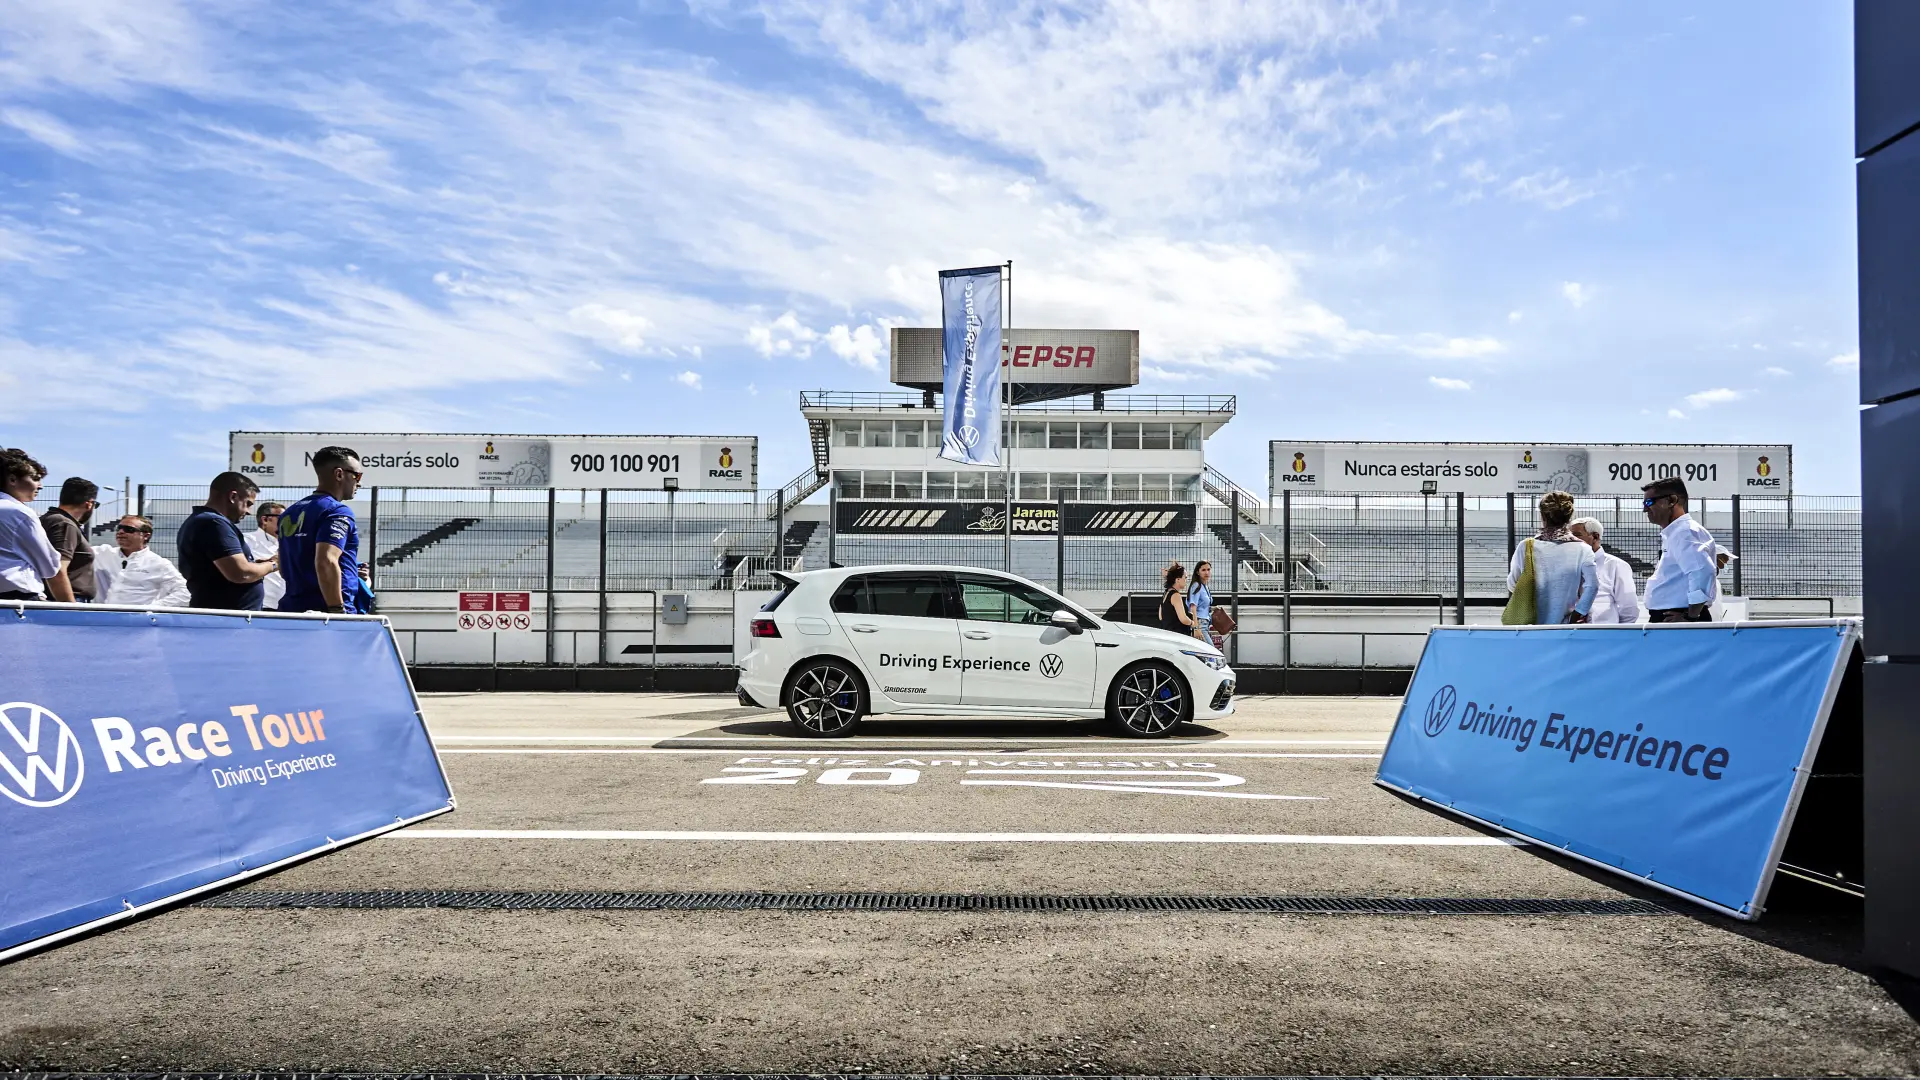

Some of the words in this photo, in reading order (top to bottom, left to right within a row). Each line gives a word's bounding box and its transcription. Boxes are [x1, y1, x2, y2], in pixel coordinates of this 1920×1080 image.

[361, 451, 422, 468] estarás
[425, 453, 460, 468] solo
[570, 454, 605, 472] 900
[610, 454, 643, 473] 100
[647, 454, 679, 473] 901
[1344, 460, 1396, 477] Nunca
[1401, 459, 1461, 477] estarás
[1465, 461, 1498, 477] solo
[241, 465, 275, 474] RACE
[709, 469, 743, 477] RACE
[1282, 474, 1316, 482] RACE
[1608, 463, 1642, 481] 900
[1648, 463, 1681, 481] 100
[1685, 463, 1717, 481] 901
[1746, 478, 1781, 486] RACE
[1012, 507, 1058, 518] Jaram
[1012, 519, 1058, 531] RACE
[879, 653, 937, 671] Driving
[942, 655, 1031, 672] Experience
[883, 685, 928, 694] BRIDGESTONE
[91, 715, 234, 773] Race
[229, 704, 325, 751] Tour
[1458, 701, 1537, 752] Driving
[1540, 712, 1730, 781] Experience
[212, 763, 267, 789] Driving
[265, 752, 337, 779] Experience
[734, 757, 870, 765] Feliz
[884, 757, 1217, 769] Aniversario
[700, 767, 921, 785] 20
